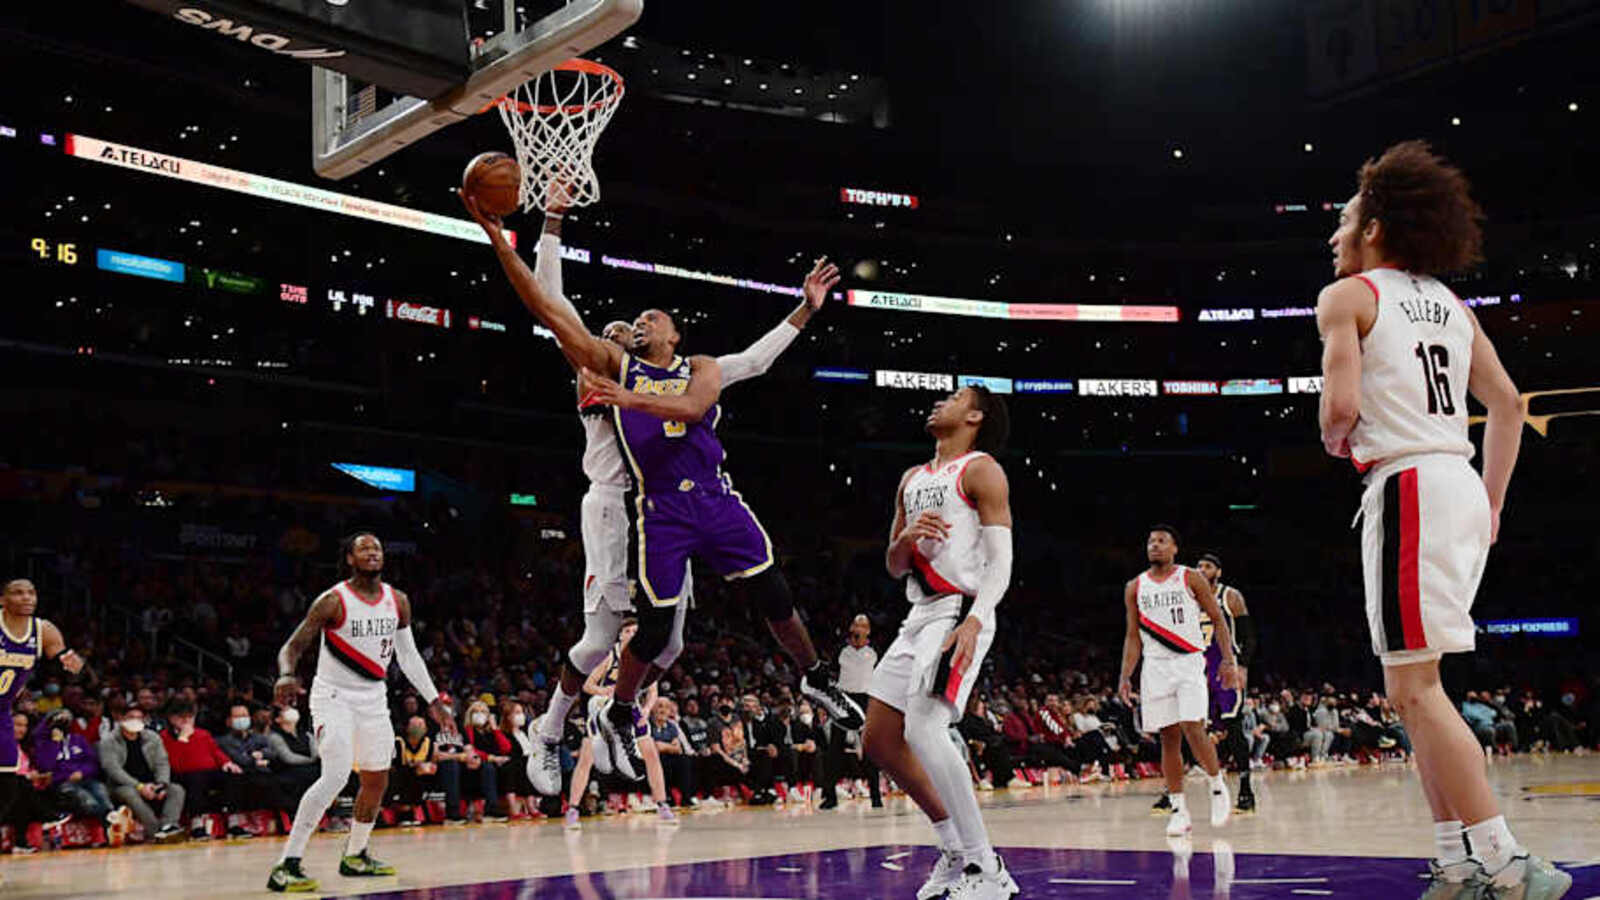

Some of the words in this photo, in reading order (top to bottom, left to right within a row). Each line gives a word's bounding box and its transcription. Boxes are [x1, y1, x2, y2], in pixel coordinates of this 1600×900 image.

[1399, 299, 1452, 327] ELLEBY
[882, 372, 950, 391] LAKERS
[1164, 381, 1218, 394] TOSHIBA
[1414, 340, 1456, 416] 16
[1085, 380, 1153, 396] LAKERS
[1170, 606, 1185, 625] 10
